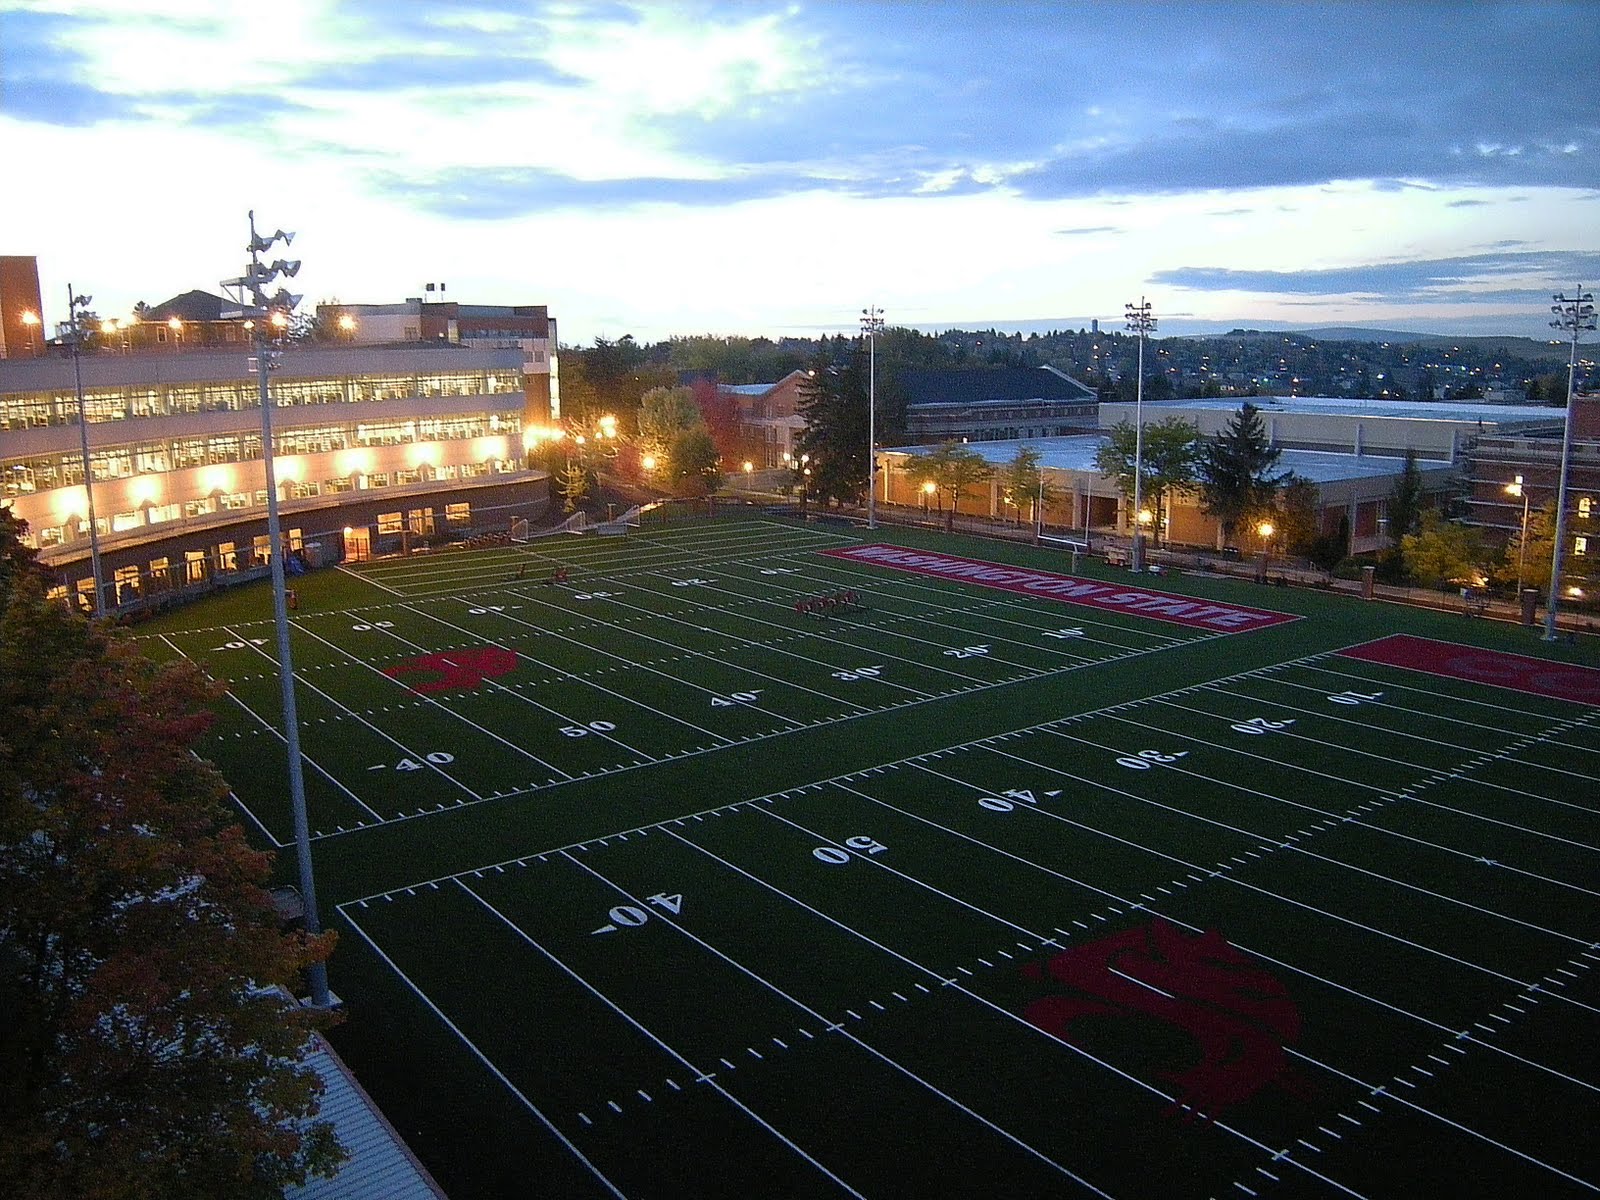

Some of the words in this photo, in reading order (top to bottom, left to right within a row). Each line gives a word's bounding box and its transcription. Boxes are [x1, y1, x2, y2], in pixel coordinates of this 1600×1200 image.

[1100, 592, 1268, 627] STATE
[943, 646, 987, 660] 20
[831, 667, 882, 682] 30
[710, 692, 760, 708] 40
[1327, 691, 1376, 706] 10
[559, 720, 617, 738] 50
[1230, 717, 1285, 735] 20
[396, 752, 455, 771] 40
[1116, 749, 1178, 771] 30
[977, 789, 1037, 813] 40
[812, 835, 889, 865] 50
[608, 892, 683, 927] 40
